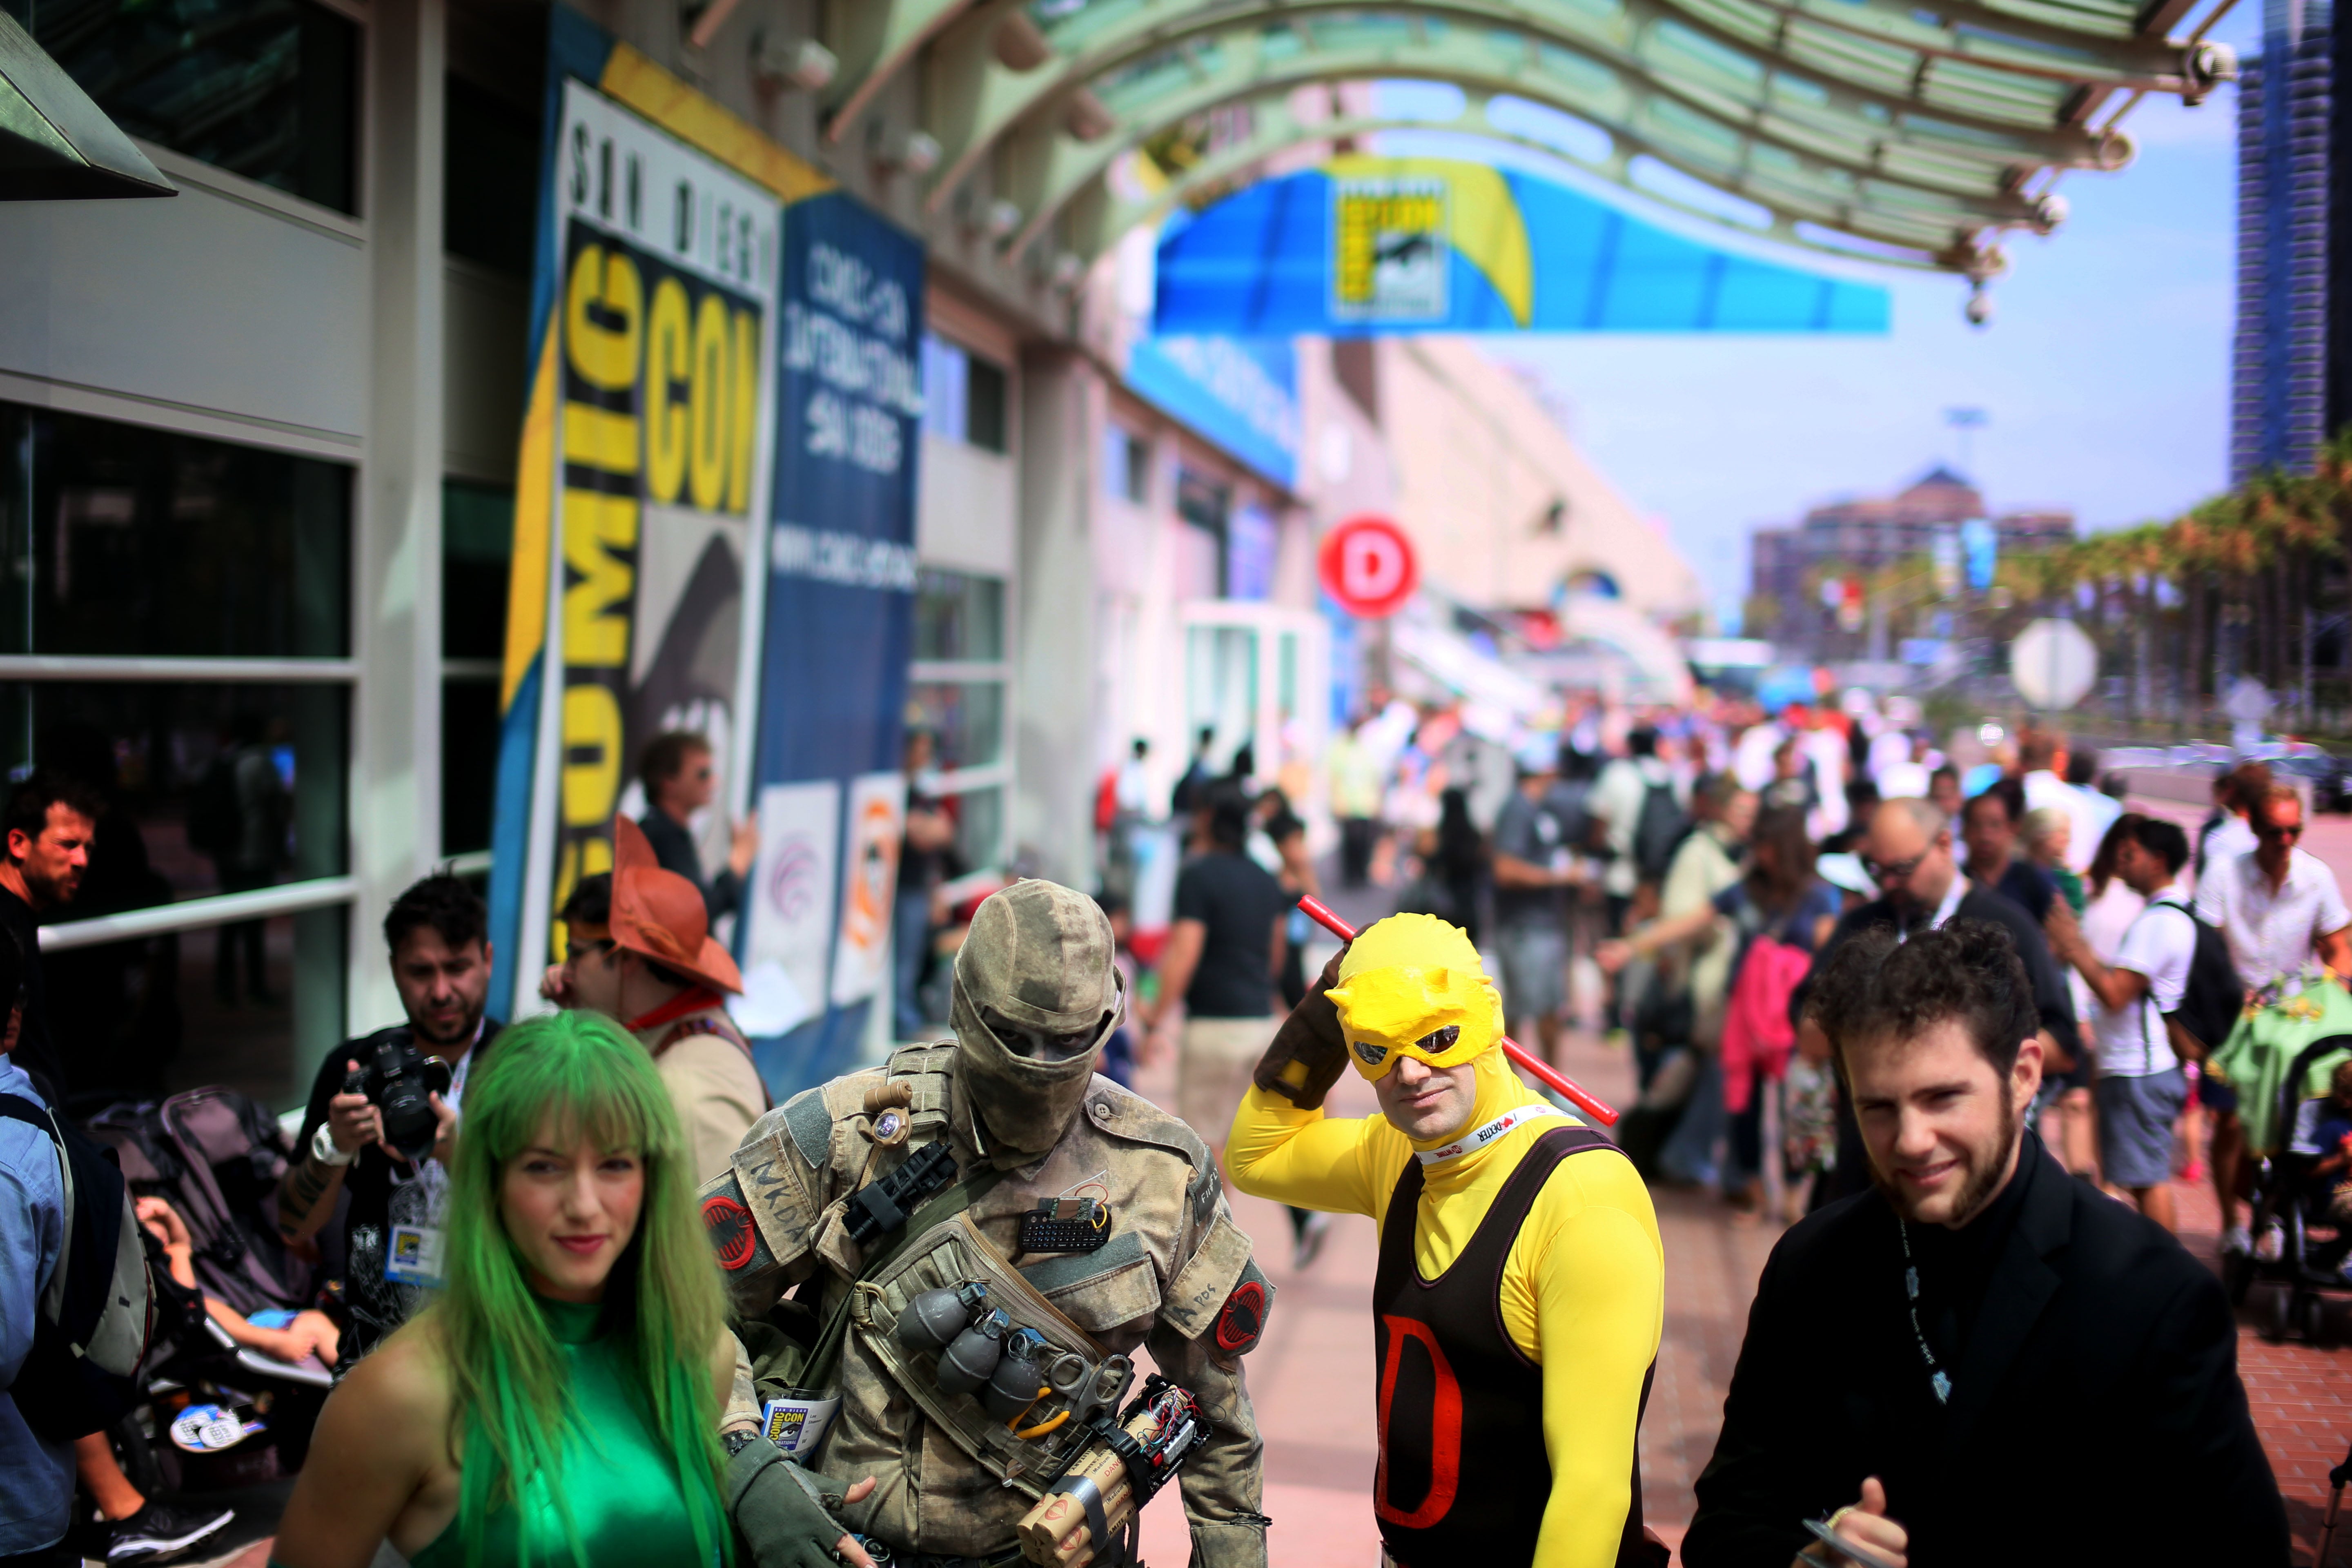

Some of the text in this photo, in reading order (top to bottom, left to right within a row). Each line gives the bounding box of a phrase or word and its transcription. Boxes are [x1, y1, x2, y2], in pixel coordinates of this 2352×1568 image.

[645, 275, 760, 514] CON
[1342, 530, 1404, 599] D
[1477, 1122, 1503, 1143] DEXTER
[1433, 1145, 1463, 1159] SHOWTIME
[750, 1159, 809, 1244] NKDA
[1173, 1306, 1198, 1327] A
[769, 1412, 785, 1441] COMIC
[784, 1412, 804, 1422] CON
[1375, 1314, 1463, 1529] D
